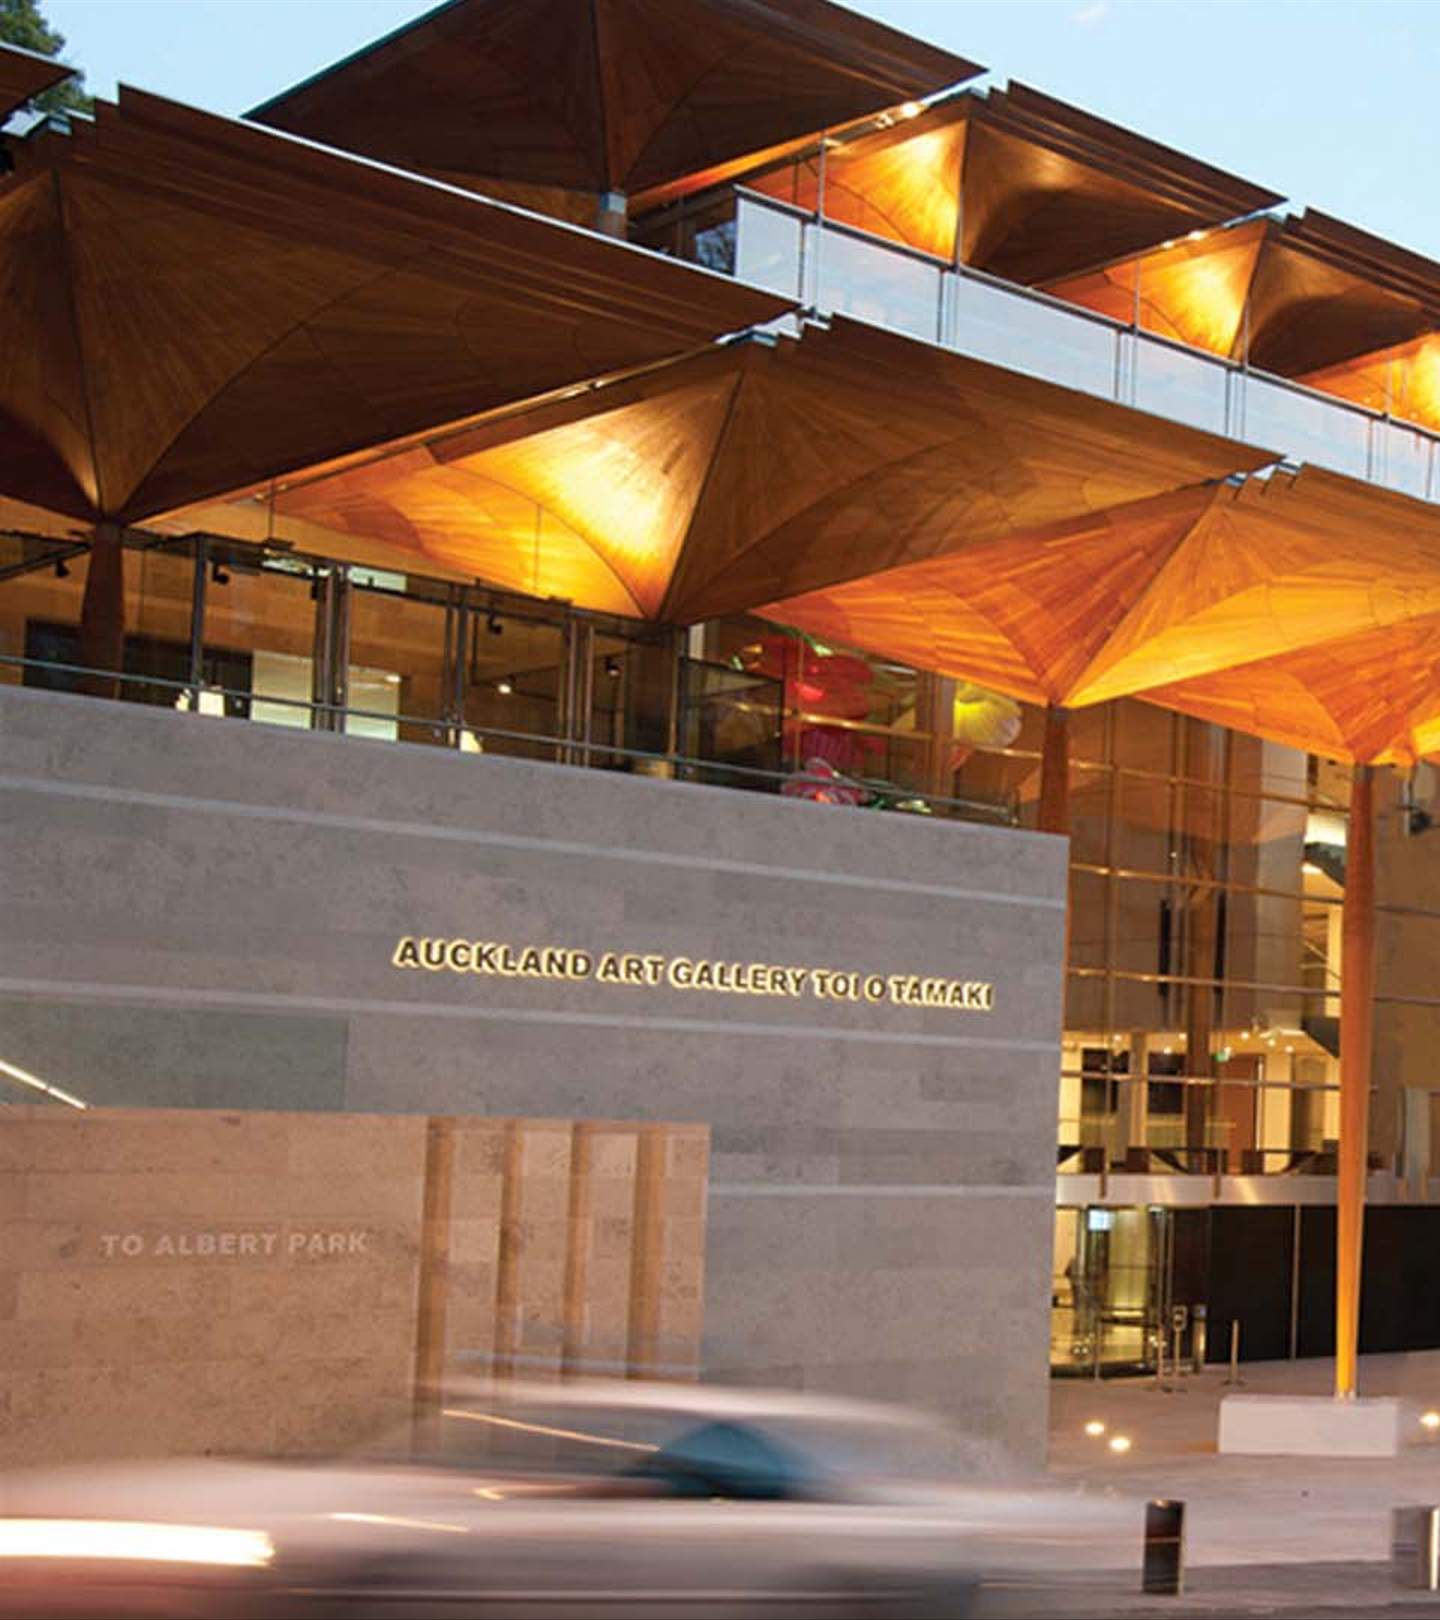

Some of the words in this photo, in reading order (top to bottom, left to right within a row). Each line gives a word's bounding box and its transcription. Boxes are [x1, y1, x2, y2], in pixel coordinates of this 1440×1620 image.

[394, 938, 592, 978] AUCKLAND
[597, 954, 664, 983] ART
[669, 958, 807, 995] GALLERY
[811, 970, 859, 999] TOI
[865, 975, 886, 1002] O
[100, 1234, 145, 1256] TO
[154, 1232, 278, 1255] ALBERT
[287, 1232, 368, 1253] PARK
